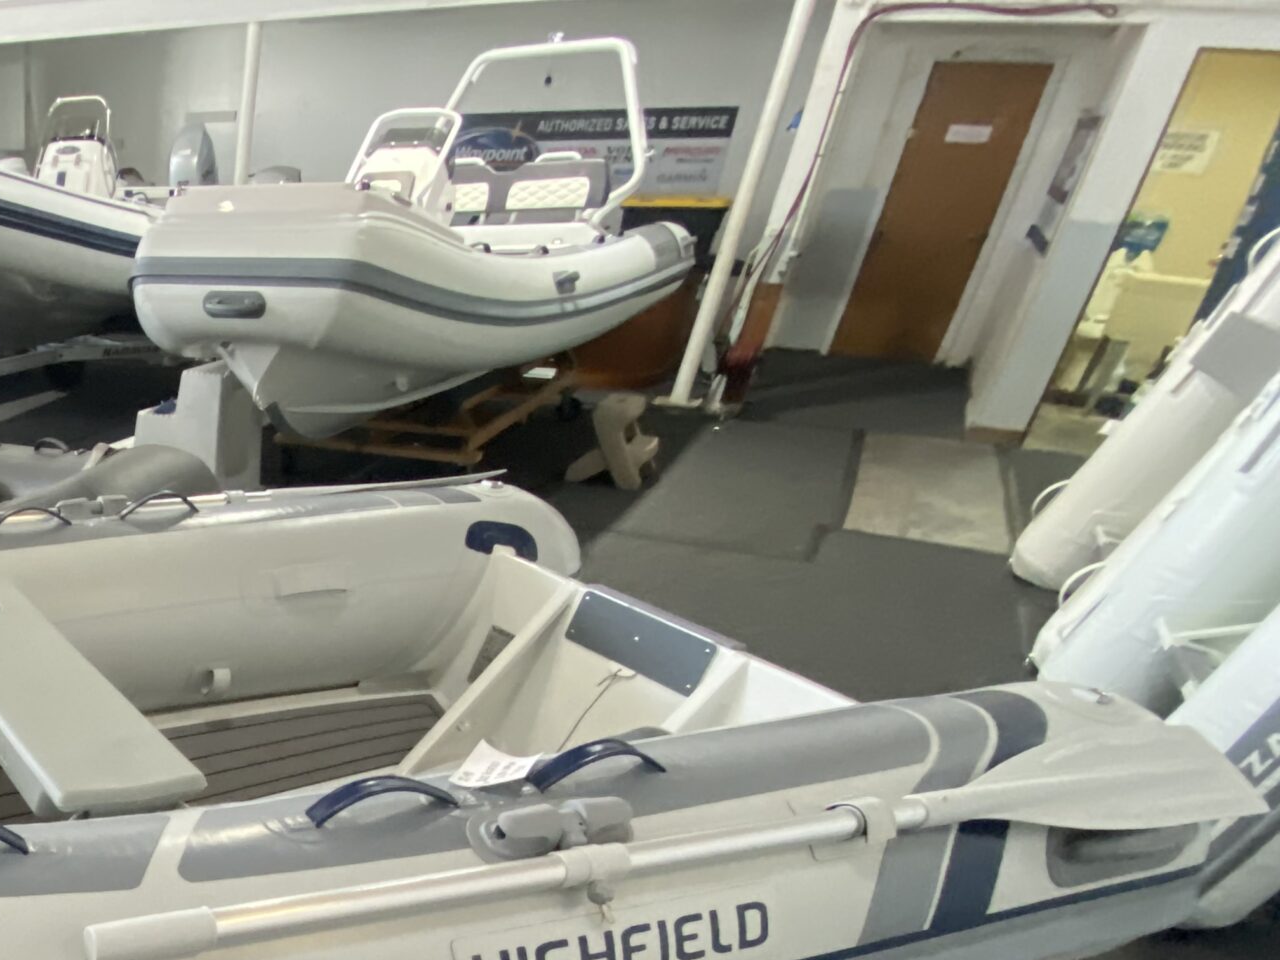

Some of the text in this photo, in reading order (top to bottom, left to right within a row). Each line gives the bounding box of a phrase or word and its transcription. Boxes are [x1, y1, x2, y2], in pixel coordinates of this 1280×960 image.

[537, 118, 613, 133] AUTHORIZED
[658, 116, 668, 130] &
[671, 115, 730, 130] SERVICE
